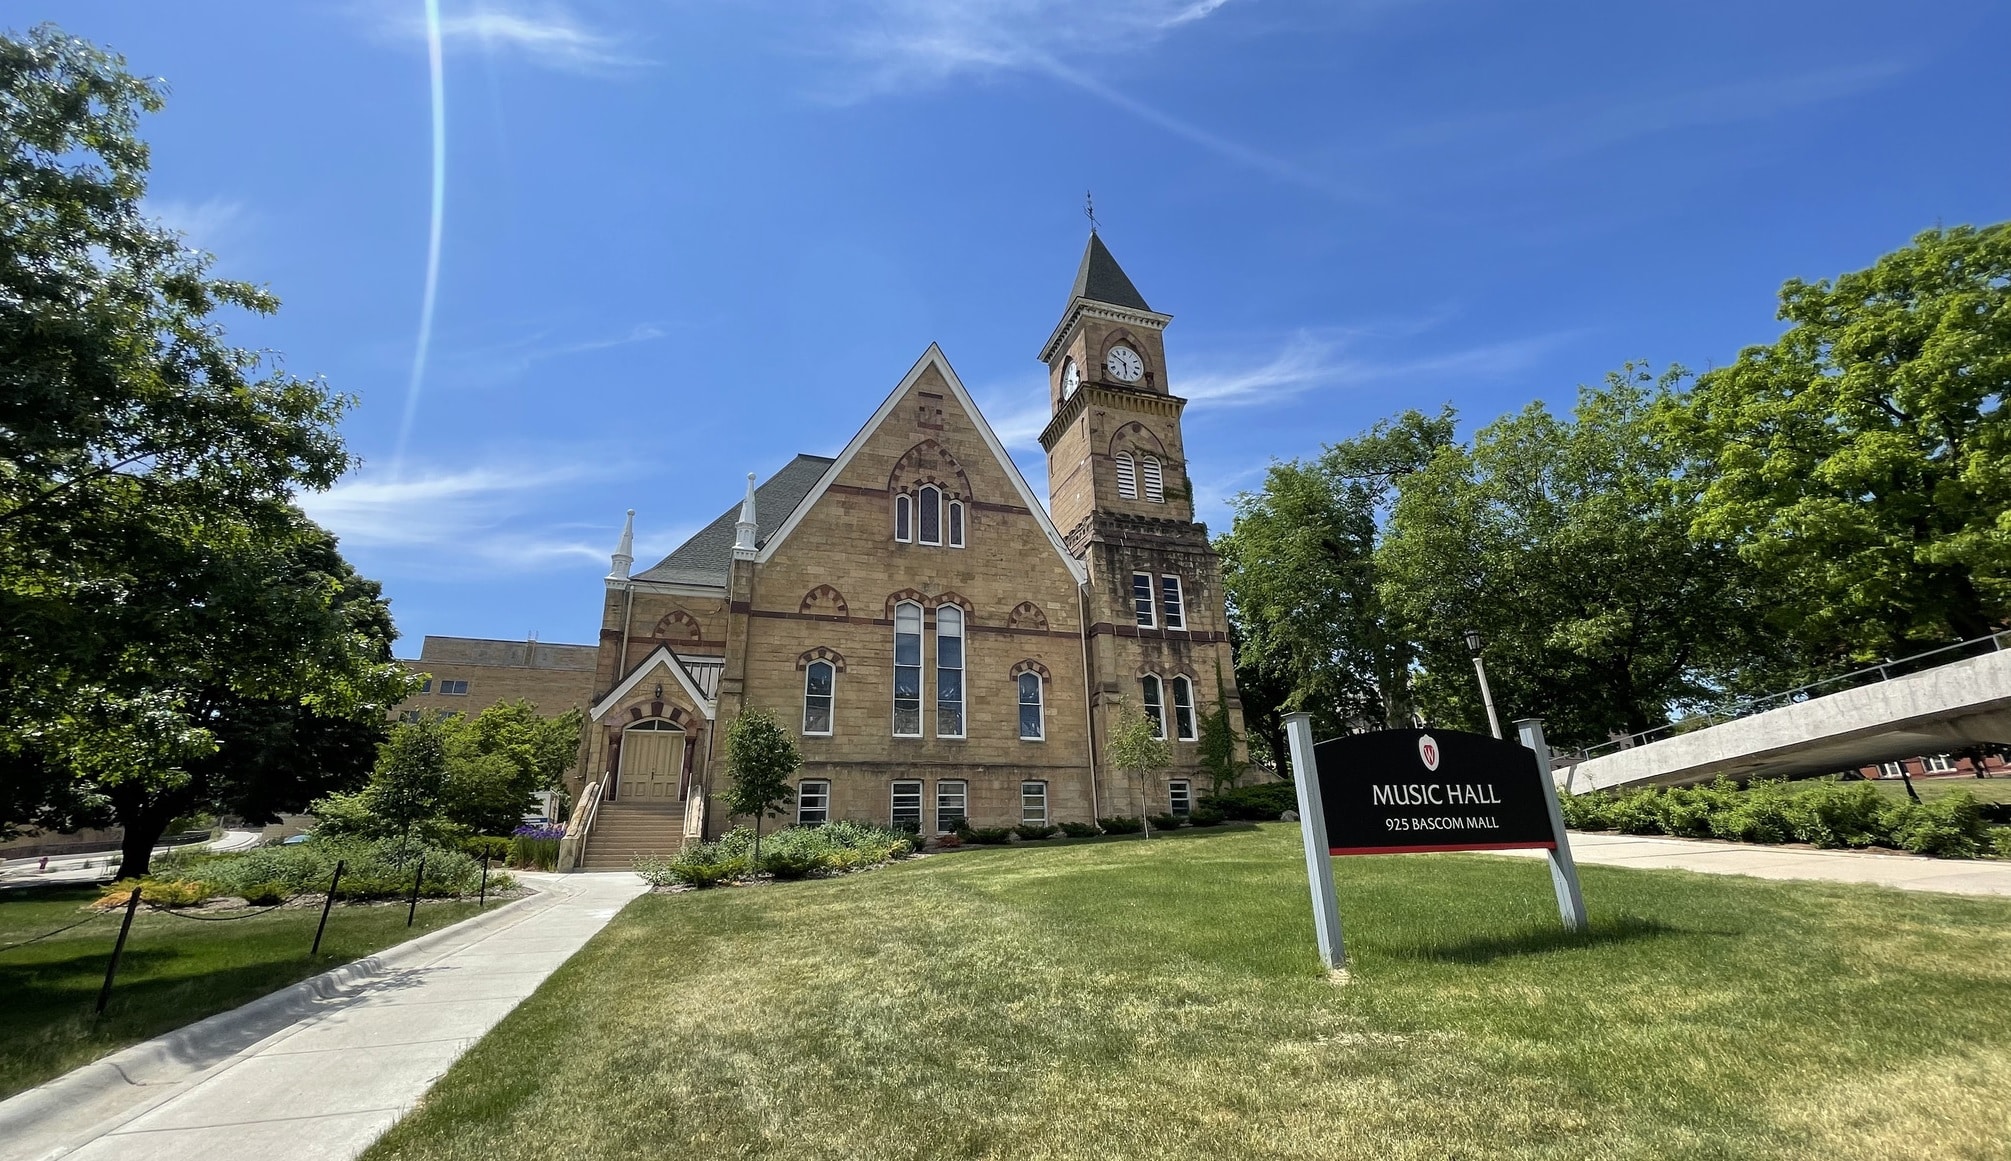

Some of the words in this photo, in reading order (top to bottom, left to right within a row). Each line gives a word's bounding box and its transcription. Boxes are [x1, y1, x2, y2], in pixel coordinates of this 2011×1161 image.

[1372, 784, 1443, 806] MUSIC
[1446, 784, 1501, 805] HALL
[1385, 818, 1410, 831] 925
[1412, 817, 1464, 831] BASCOM
[1466, 816, 1499, 830] MALL
